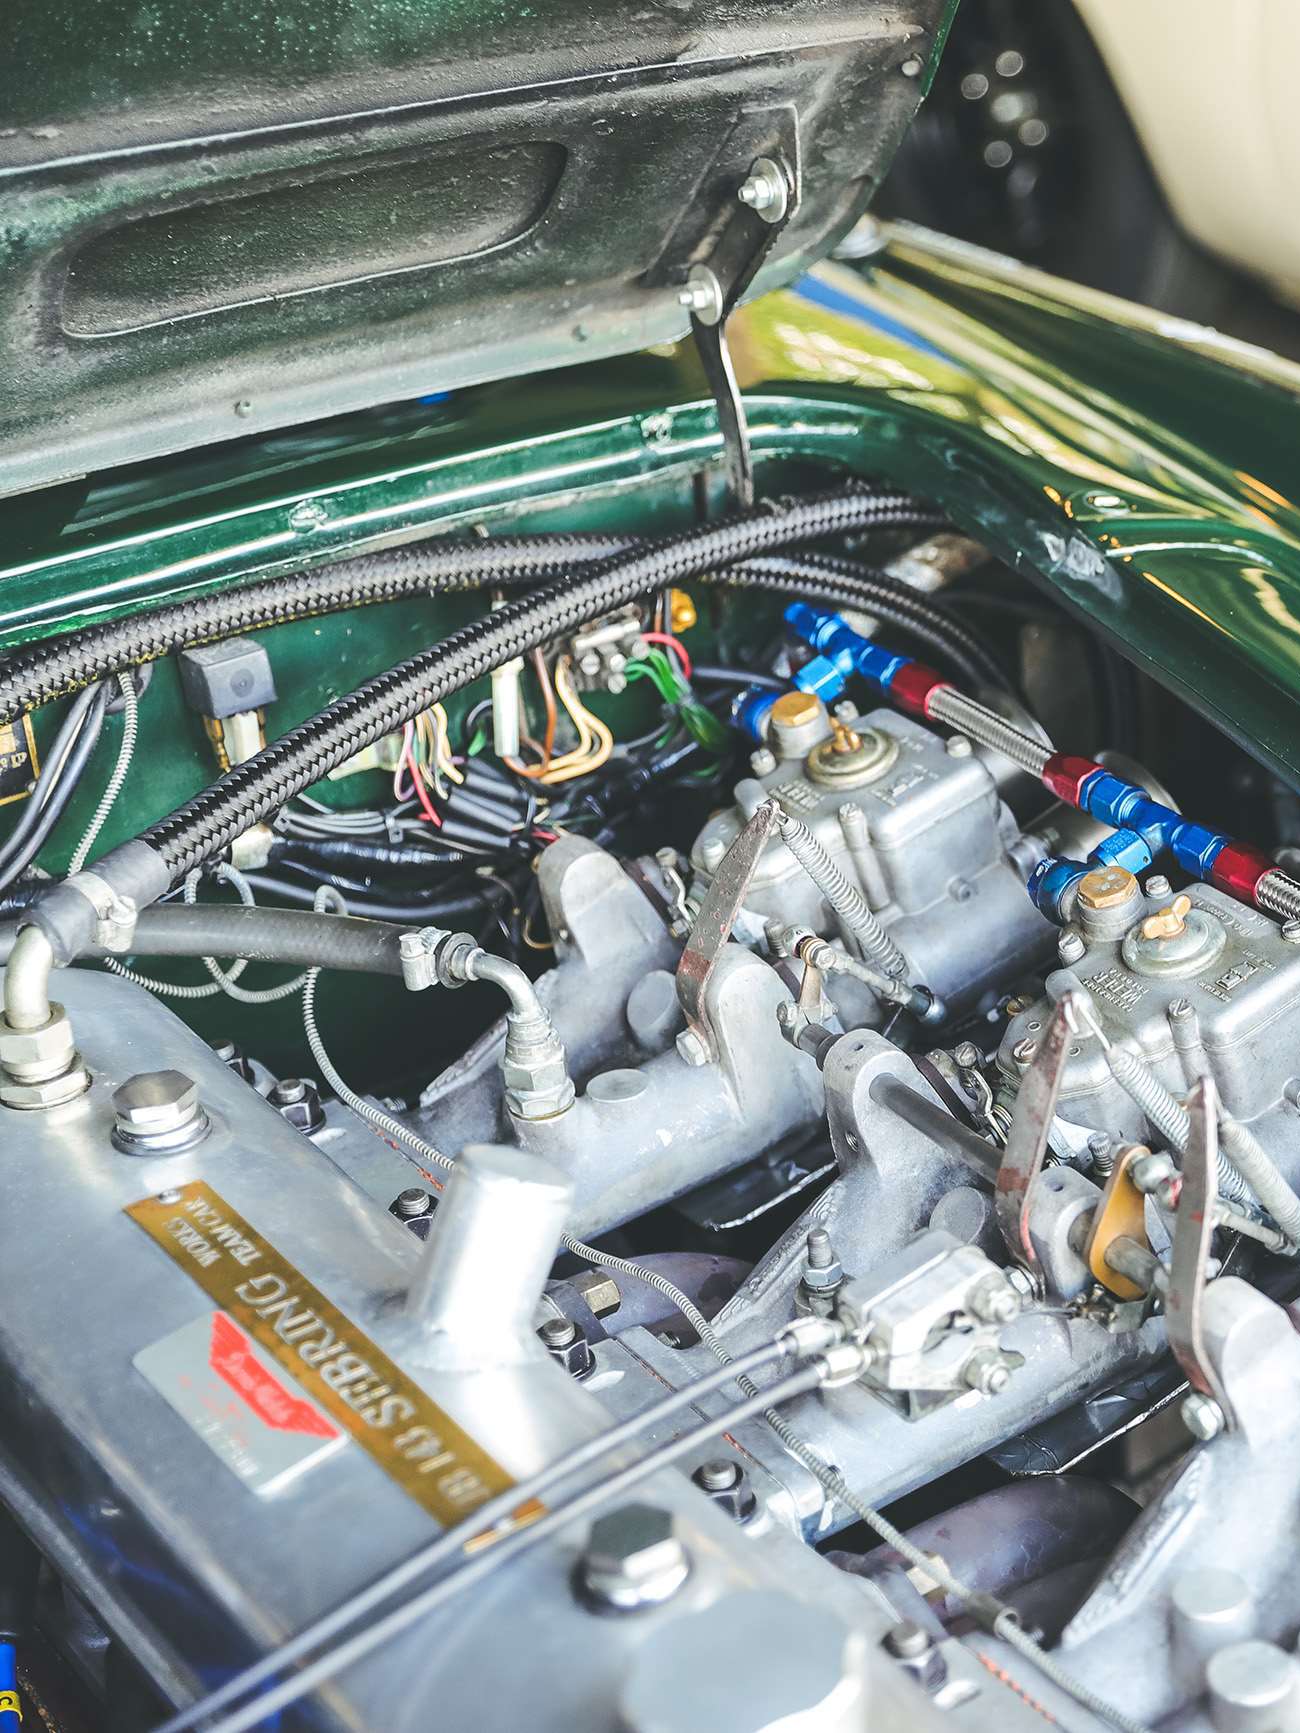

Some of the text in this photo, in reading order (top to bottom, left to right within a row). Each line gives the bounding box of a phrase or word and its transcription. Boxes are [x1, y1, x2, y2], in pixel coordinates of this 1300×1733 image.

[1092, 971, 1143, 1005] WEBER
[163, 1216, 222, 1269] WORKS
[186, 1196, 262, 1267] TEAM CAR
[234, 1272, 417, 1430] SEBRING
